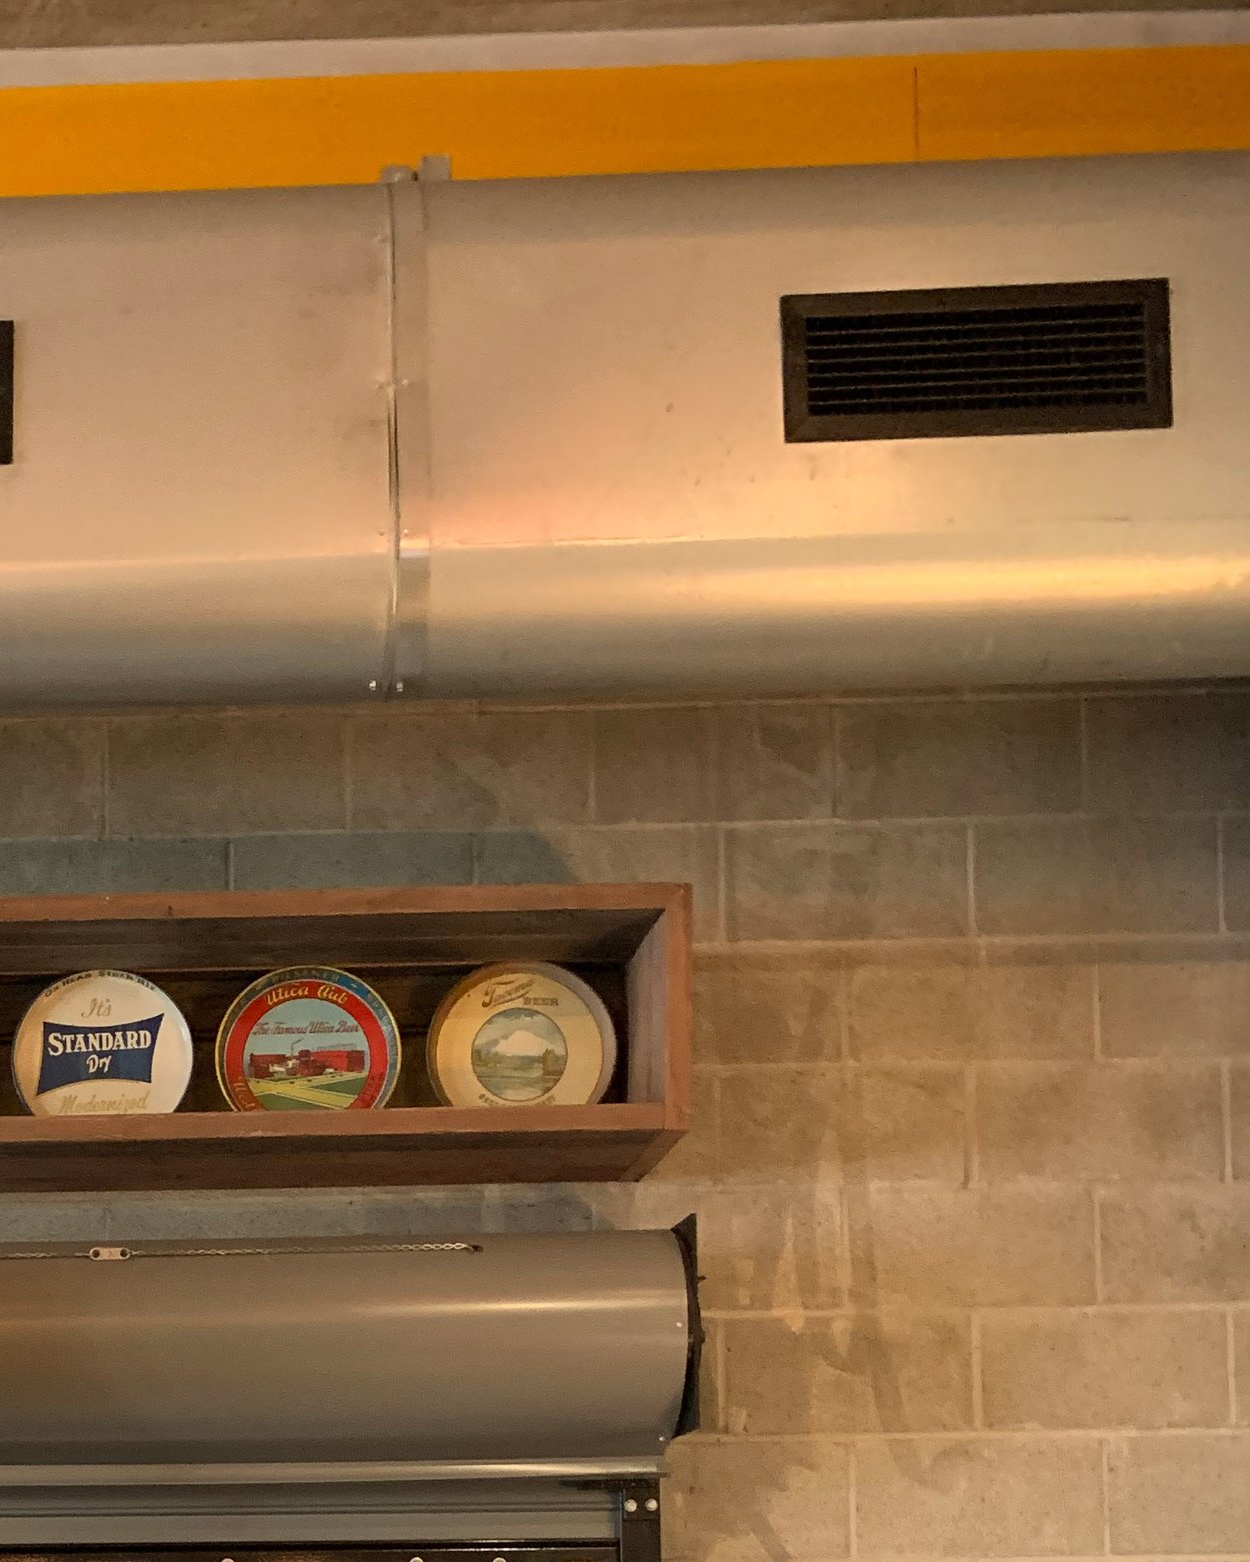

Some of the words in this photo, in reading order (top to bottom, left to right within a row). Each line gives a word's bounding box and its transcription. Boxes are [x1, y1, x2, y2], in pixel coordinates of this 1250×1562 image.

[265, 984, 310, 1006] Utica
[80, 997, 113, 1018] It's
[335, 1020, 360, 1034] Beer
[47, 1029, 152, 1056] STANDARD
[86, 1054, 113, 1074] Dry
